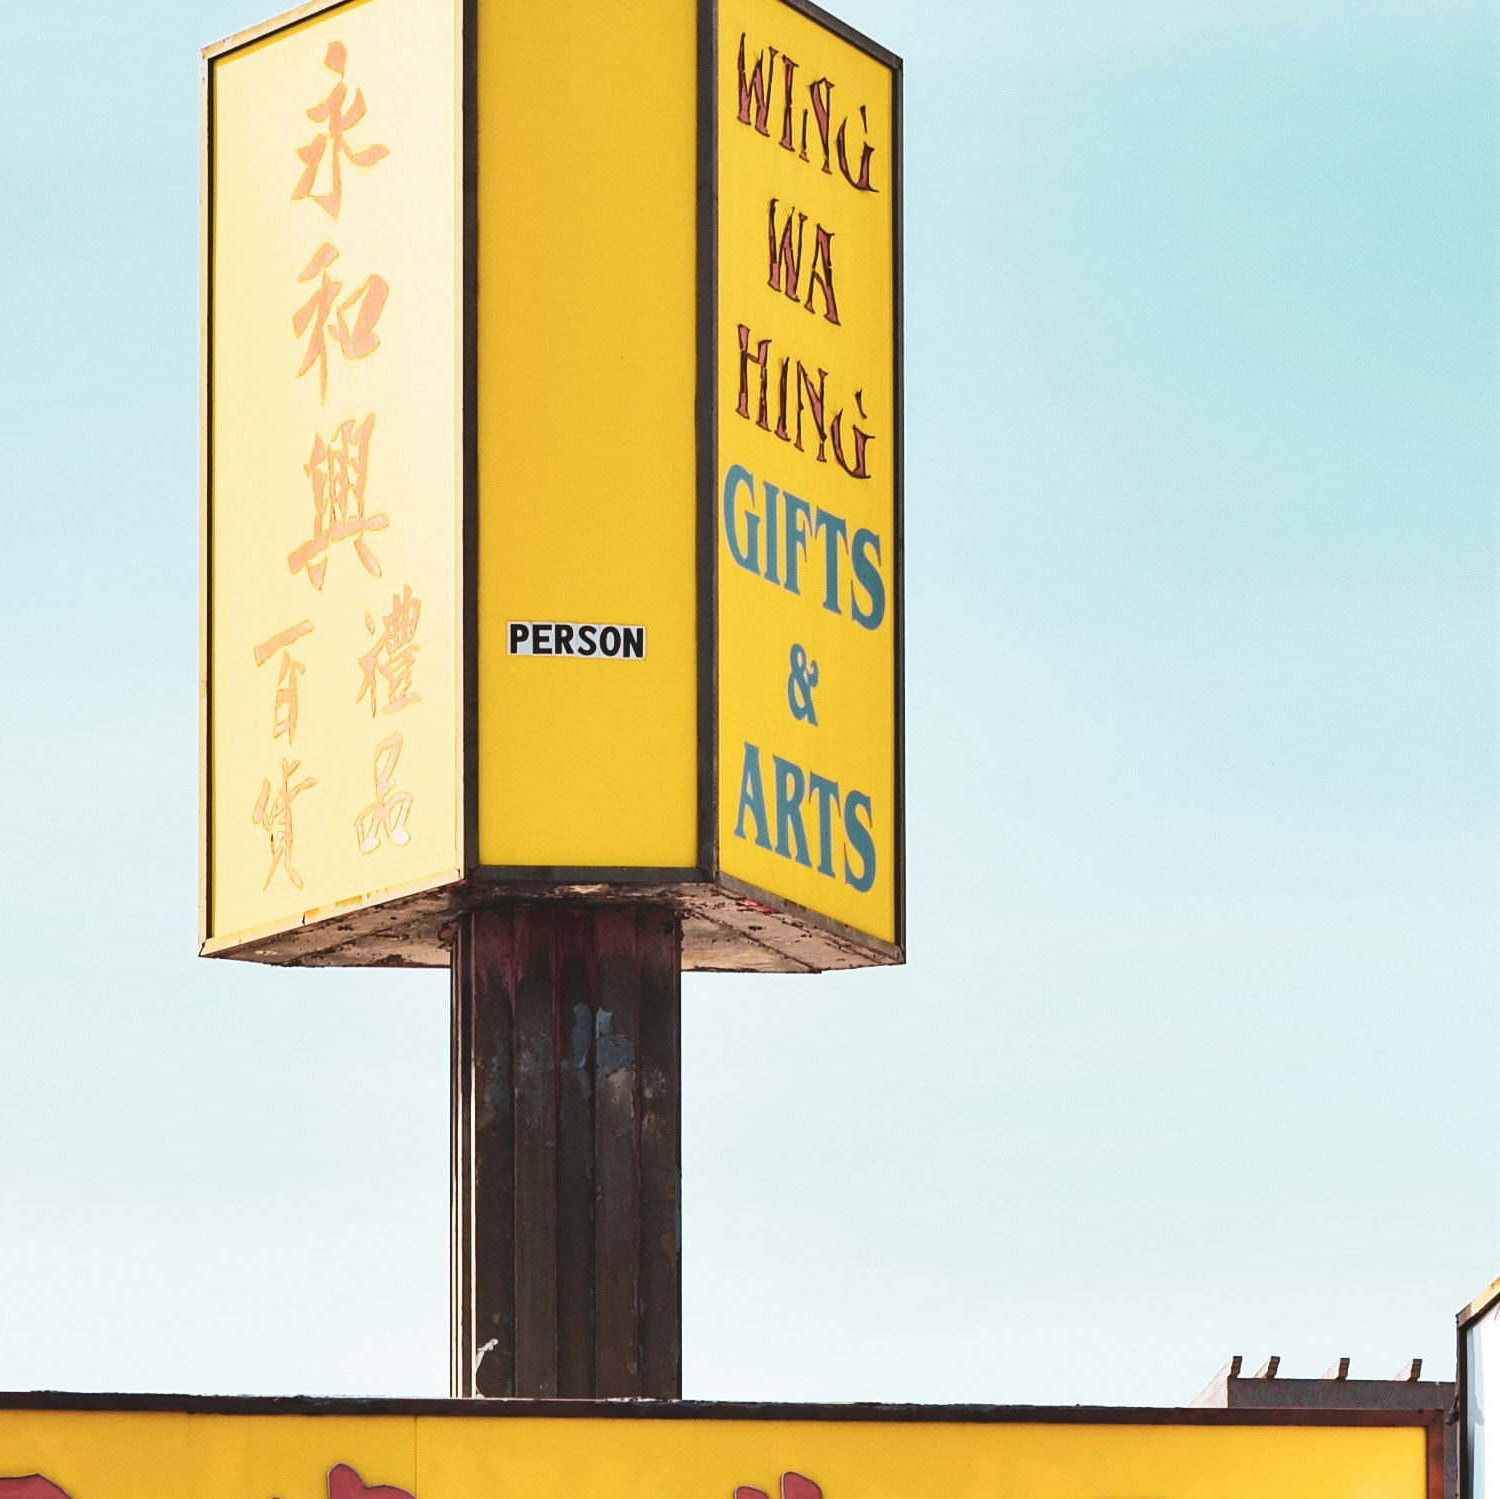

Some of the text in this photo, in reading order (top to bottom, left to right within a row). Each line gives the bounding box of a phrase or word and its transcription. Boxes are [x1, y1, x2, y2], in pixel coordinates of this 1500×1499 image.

[736, 31, 879, 194] WING
[289, 40, 389, 590] 永和興
[767, 197, 841, 326] WA
[736, 323, 872, 480] HING
[722, 464, 887, 632] GIFTS
[509, 622, 645, 658] PERSON
[787, 642, 820, 727] &
[734, 742, 877, 893] ARTS
